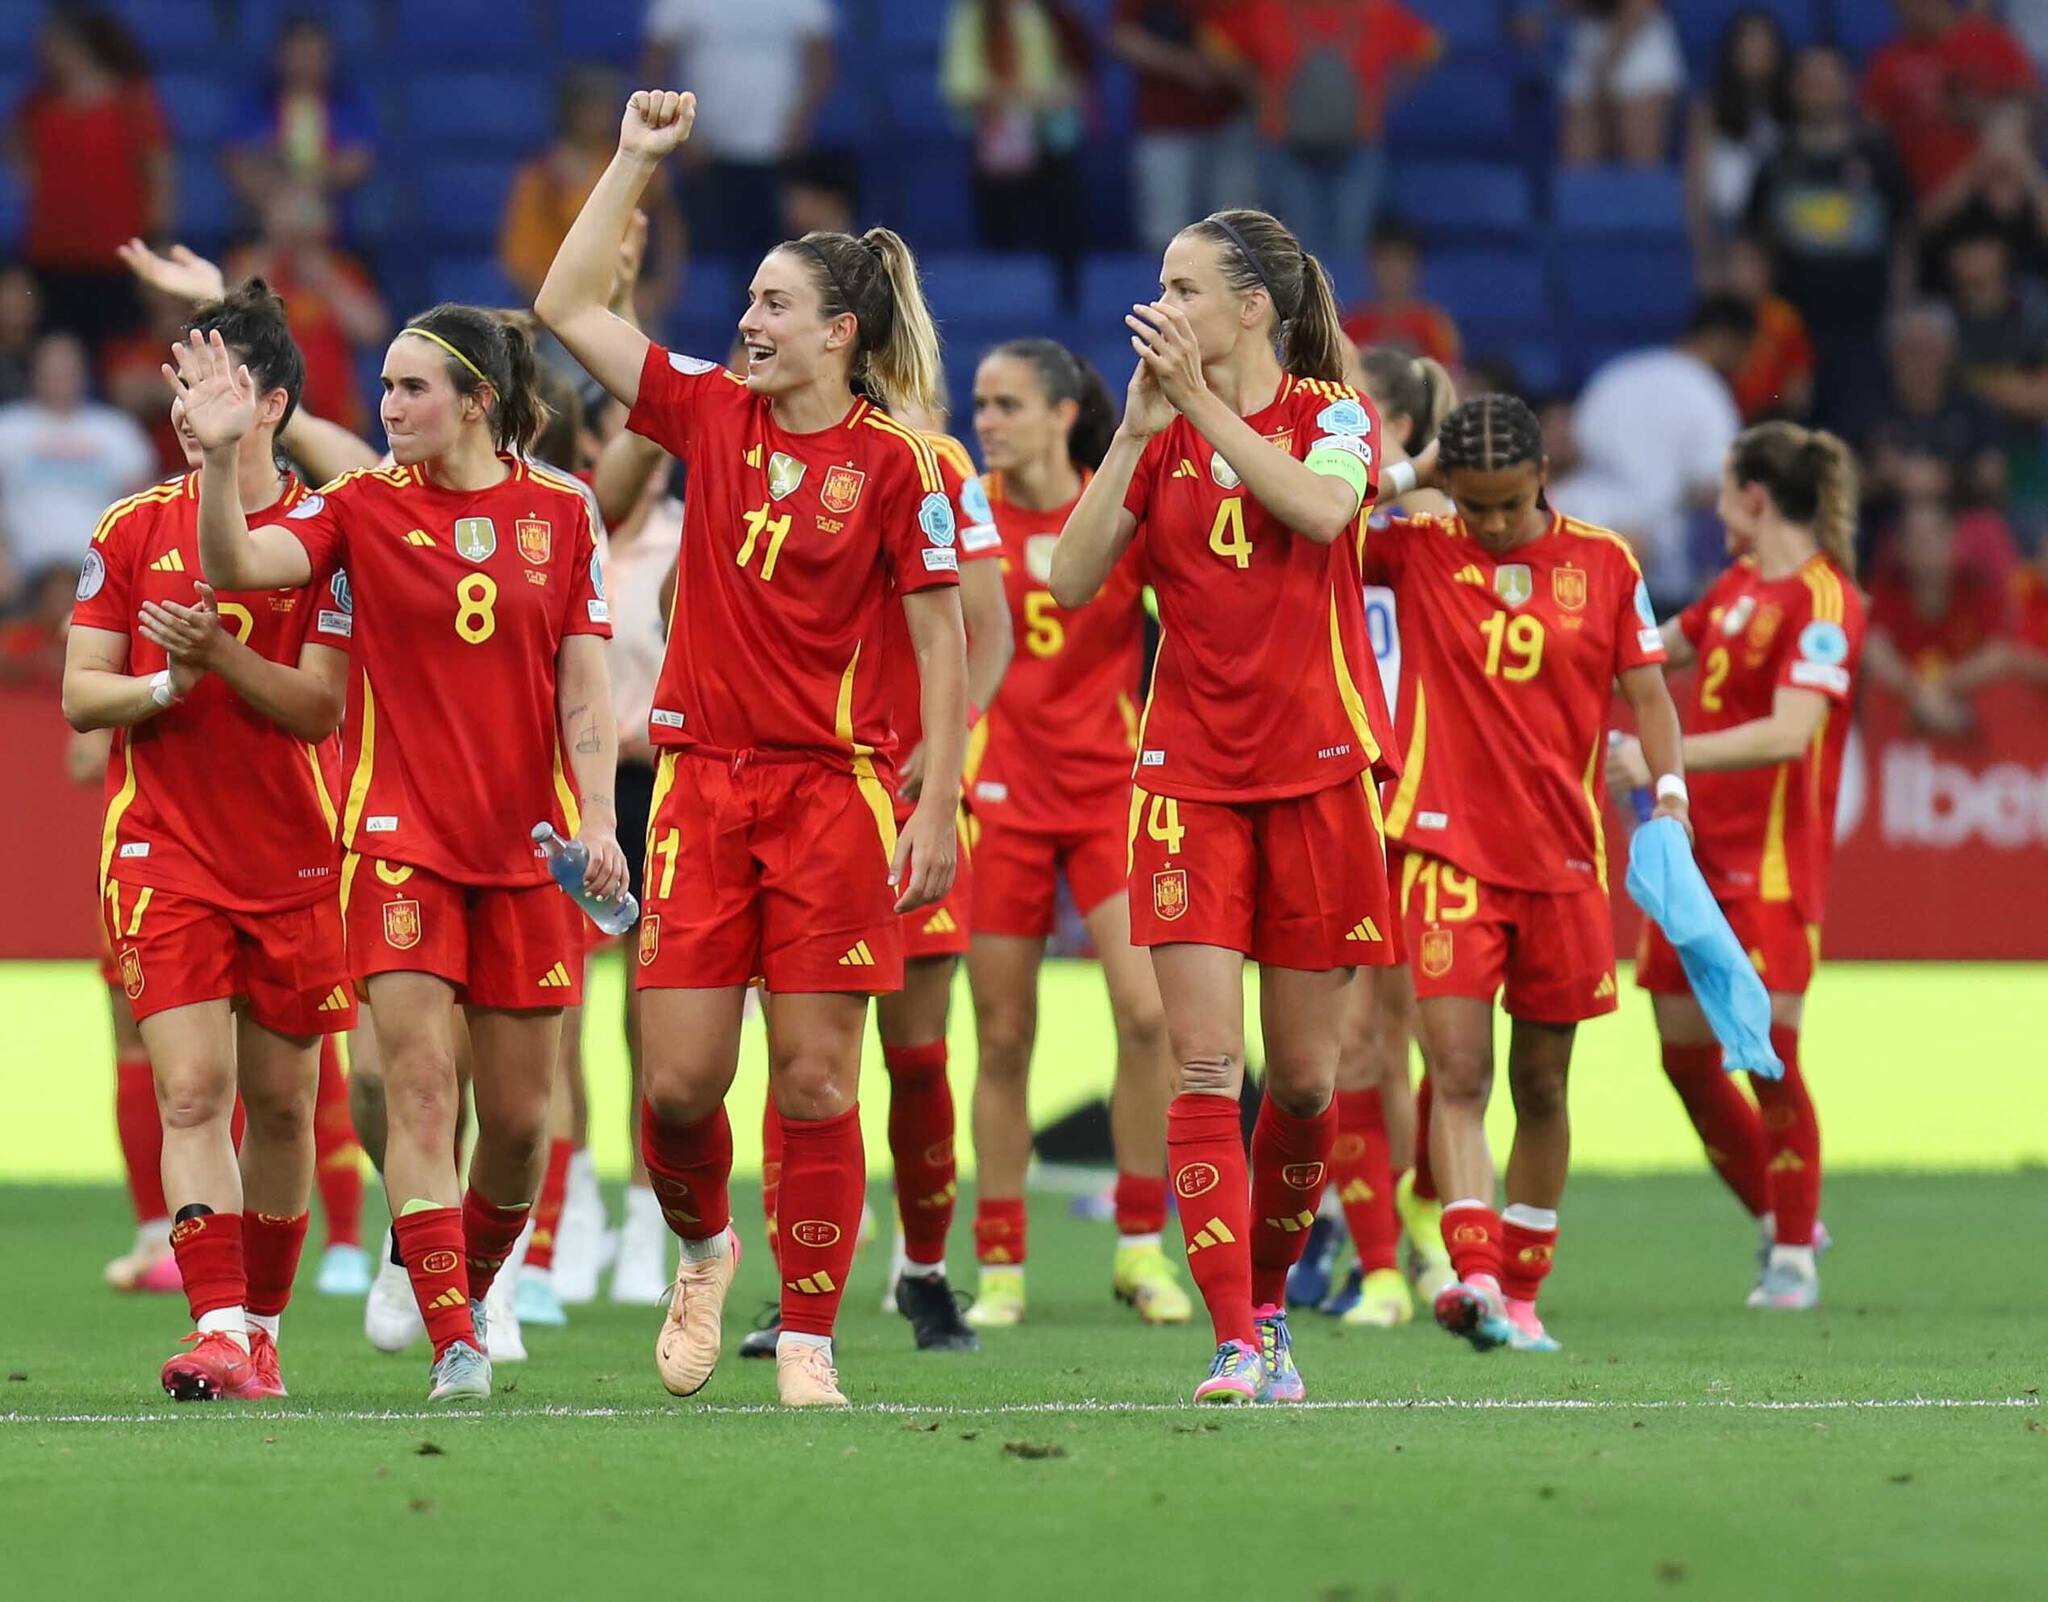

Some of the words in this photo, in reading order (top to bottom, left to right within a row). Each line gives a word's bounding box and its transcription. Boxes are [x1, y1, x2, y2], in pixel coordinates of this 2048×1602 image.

[736, 502, 792, 582] 11
[1208, 496, 1253, 569] 4
[454, 571, 498, 645] 8
[1024, 590, 1065, 658] 5
[1479, 609, 1545, 680] 19
[1701, 647, 1730, 712] 2
[1147, 794, 1185, 855] 4
[1879, 738, 2048, 849] Ibe
